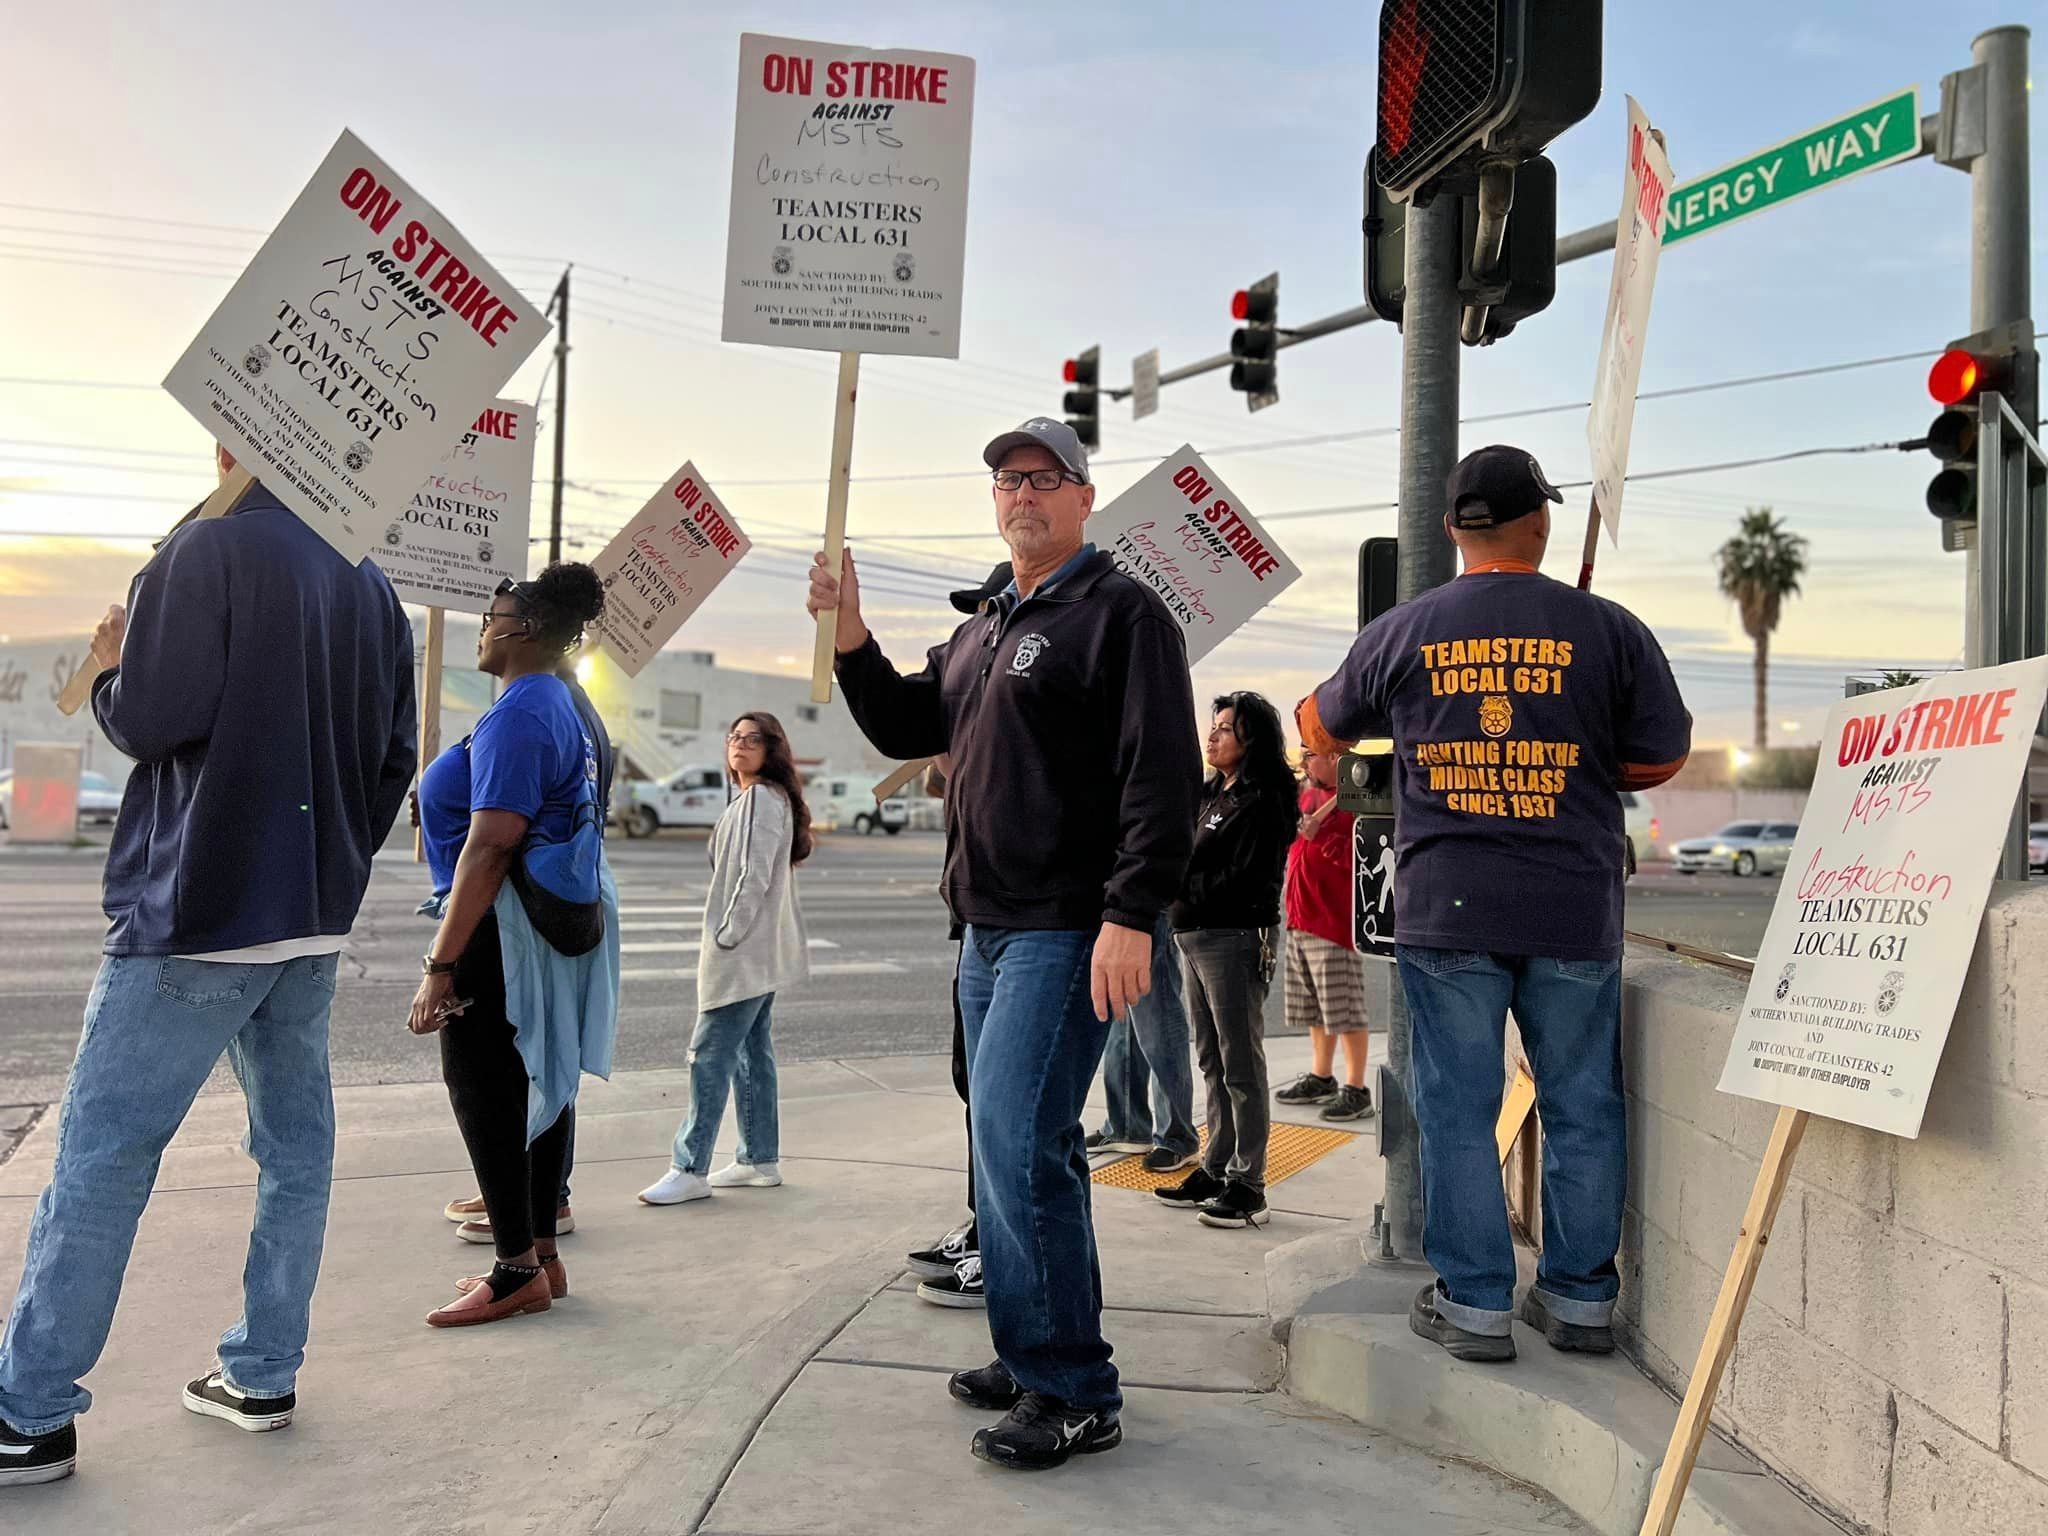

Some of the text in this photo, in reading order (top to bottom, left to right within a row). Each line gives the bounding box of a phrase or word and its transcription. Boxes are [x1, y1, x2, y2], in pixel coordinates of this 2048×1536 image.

[763, 54, 947, 103] ON STRIKE
[812, 103, 895, 120] AGAINST
[796, 120, 904, 148] MSTS
[1665, 157, 1784, 231] NERGY
[1804, 113, 1891, 178] WAY
[772, 198, 921, 223] TEAMSTERS
[1637, 156, 1664, 239] RIKE
[782, 223, 907, 247] LOCAL 631
[340, 168, 516, 346] ON STRIKE
[366, 250, 445, 319] AGAINST
[741, 279, 942, 300] SOUTHERN NEVADA BUILDING TRADES
[799, 271, 867, 282] SANCTIONED
[322, 254, 438, 360] MSTS
[753, 303, 784, 314] JOINT
[788, 306, 833, 317] COUNCIL
[851, 309, 914, 322] TEAMSTERS
[916, 314, 927, 324] 42
[832, 296, 852, 305] AND
[769, 317, 910, 334] NO DISPUTE WITH ANY OTHER EMPLOYER
[277, 300, 408, 430] TEAMSTERS
[309, 290, 436, 421] Construction
[268, 329, 382, 442] LOCAL 631
[207, 347, 375, 509] SOUTHERN NEVADA BUILDING TRADES
[261, 383, 336, 456] SANCTIONED BY:
[471, 408, 517, 440] IKE
[204, 378, 351, 517] JOINT COUNCIL of TEAMSTERS 42
[273, 429, 294, 449] AND
[210, 399, 330, 513] NO DISPUTE WITH ANY OTHER EMPLOYER
[396, 509, 488, 537] OCAL 631
[411, 493, 498, 522] AMSTERS
[674, 477, 739, 558] ON STRIKE
[1173, 466, 1279, 580] ON STRIKE
[665, 521, 701, 558] MSTS
[679, 517, 710, 549] AGAINST
[1174, 523, 1223, 573] MSTS
[1184, 513, 1232, 558] AGAINST
[406, 544, 459, 559] SANCTIONED
[408, 553, 441, 565] NEVADA
[442, 559, 481, 572] BUILDING
[431, 566, 448, 574] AND
[446, 577, 493, 592] TEAMSTERS
[627, 543, 679, 607] TEAMSTERS
[1115, 533, 1195, 624] TEAMSTERS
[618, 562, 651, 600] LOCAL
[649, 596, 666, 613] 631
[1420, 637, 1574, 669] TEAMSTERS
[1431, 667, 1562, 696] LOCAL 631
[1838, 689, 2015, 767] ON STRIKE
[1506, 741, 1545, 766] FOR
[1544, 742, 1580, 767] THE
[1430, 766, 1566, 795] MIDDLE CLASS
[1860, 758, 1940, 788] AGAINST
[1447, 793, 1557, 818] SINCE 1937
[1842, 779, 1931, 834] MSTS
[1799, 897, 1931, 926] TEAMSTERS
[1792, 931, 1907, 962] LOCAL 631
[1789, 994, 1867, 1014] SANCTIONED BY:
[1749, 1007, 1921, 1042] SOUTHERN NEVADA BUILDING TRADES
[1806, 1031, 1824, 1044] AND
[1747, 1039, 1894, 1077] JOINT COUNCIL of TEAMSTERS 42
[1753, 1057, 1870, 1091] NO DISPUTE WITH ANY OTHER EMPLOYER
